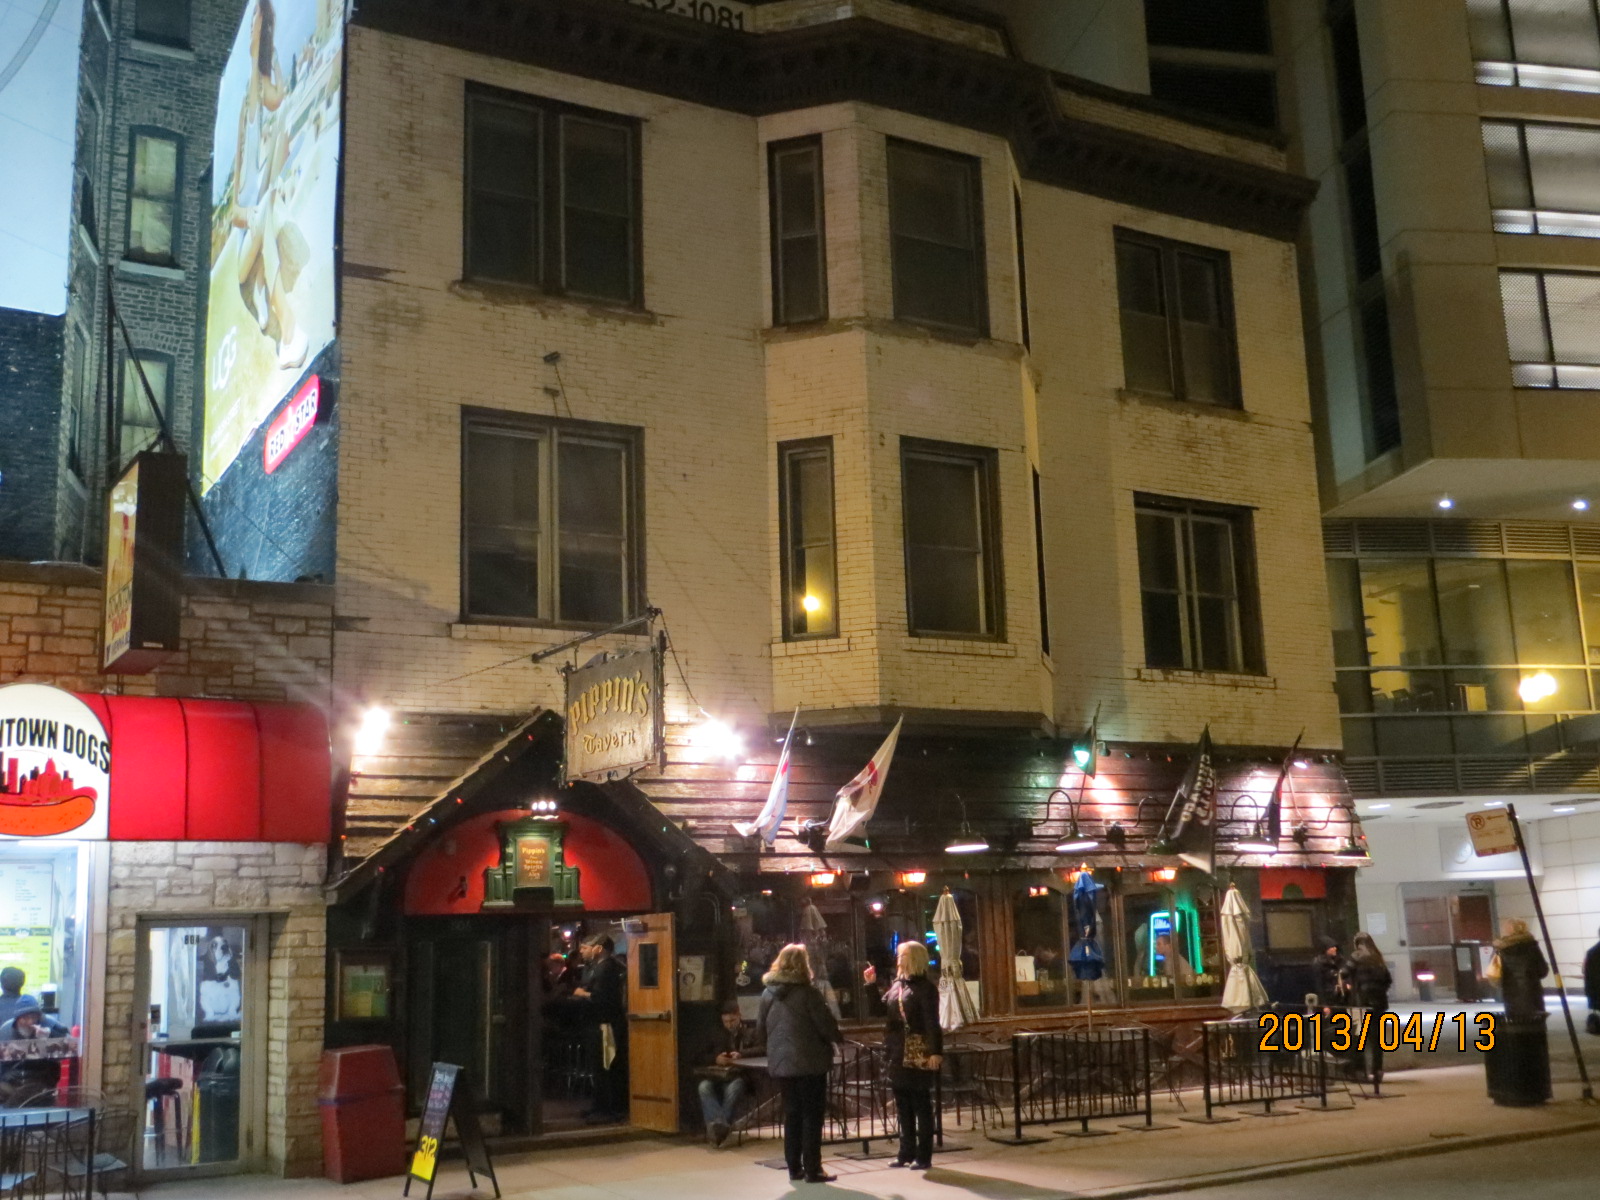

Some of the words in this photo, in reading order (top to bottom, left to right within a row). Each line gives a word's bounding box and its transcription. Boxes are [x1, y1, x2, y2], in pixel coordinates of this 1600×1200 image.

[269, 429, 286, 458] RED
[295, 391, 317, 433] STAR
[0, 717, 58, 750] TOWN
[63, 723, 110, 775] DOGS
[583, 729, 636, 755] Tavern
